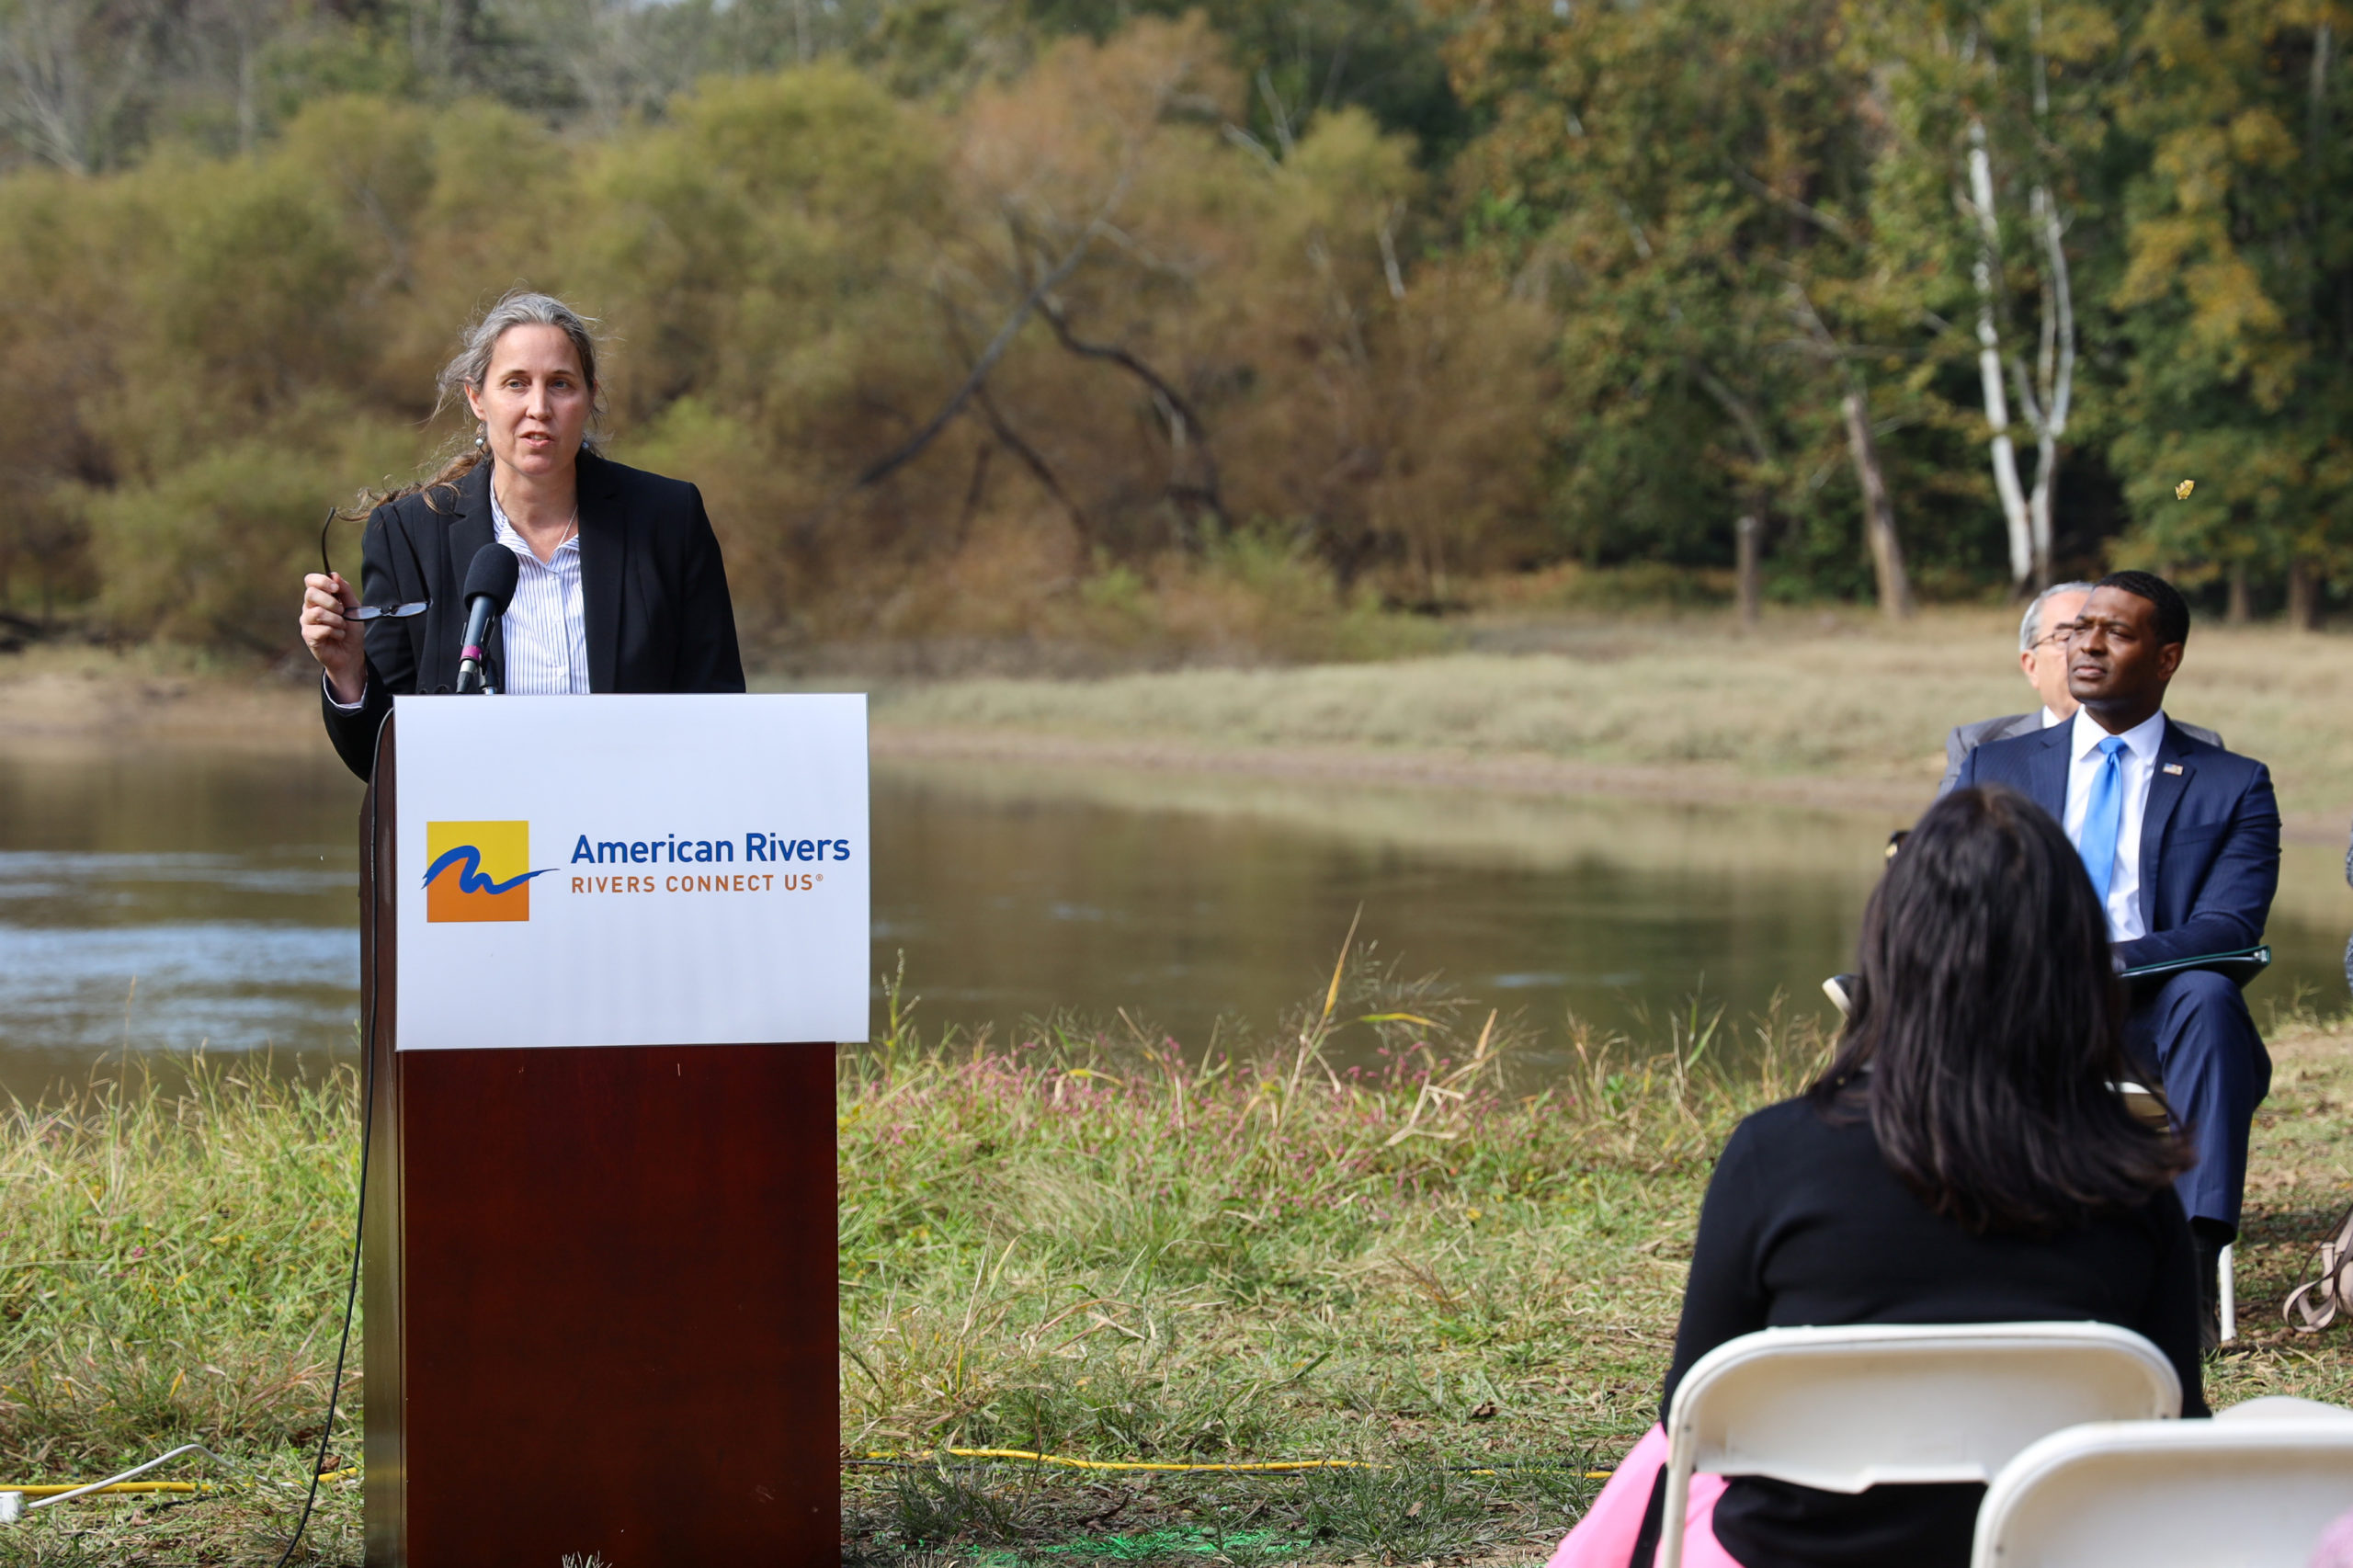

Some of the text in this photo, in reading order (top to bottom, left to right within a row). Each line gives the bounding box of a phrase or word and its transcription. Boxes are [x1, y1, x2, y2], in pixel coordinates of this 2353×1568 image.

[570, 832, 850, 864] American Rivers
[571, 876, 655, 893] RIVERS
[665, 874, 774, 892] CONNECT
